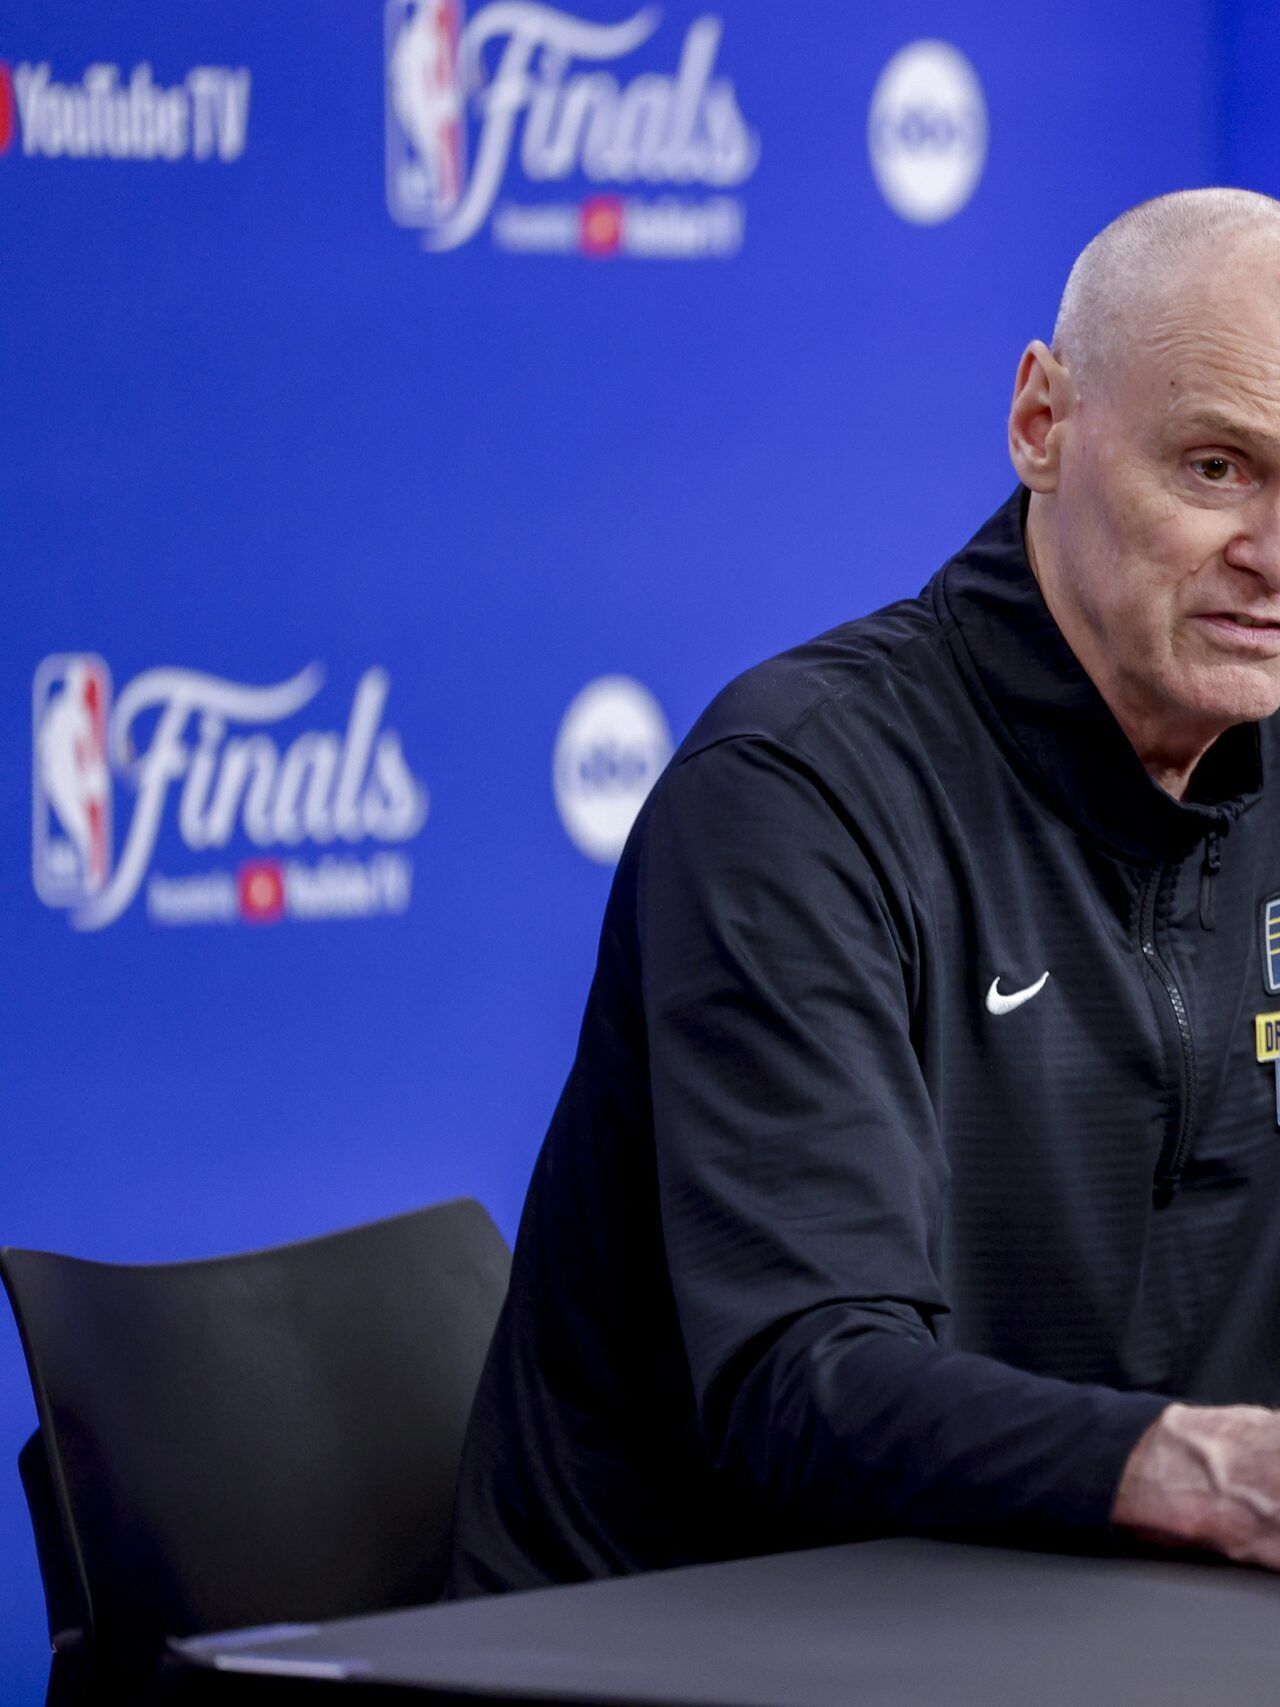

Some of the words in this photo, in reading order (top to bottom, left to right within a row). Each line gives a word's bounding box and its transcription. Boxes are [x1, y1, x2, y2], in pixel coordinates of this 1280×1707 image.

[14, 63, 188, 158] YouTube
[190, 66, 251, 161] TV
[422, 0, 761, 252] Finals
[72, 659, 428, 931] Finals
